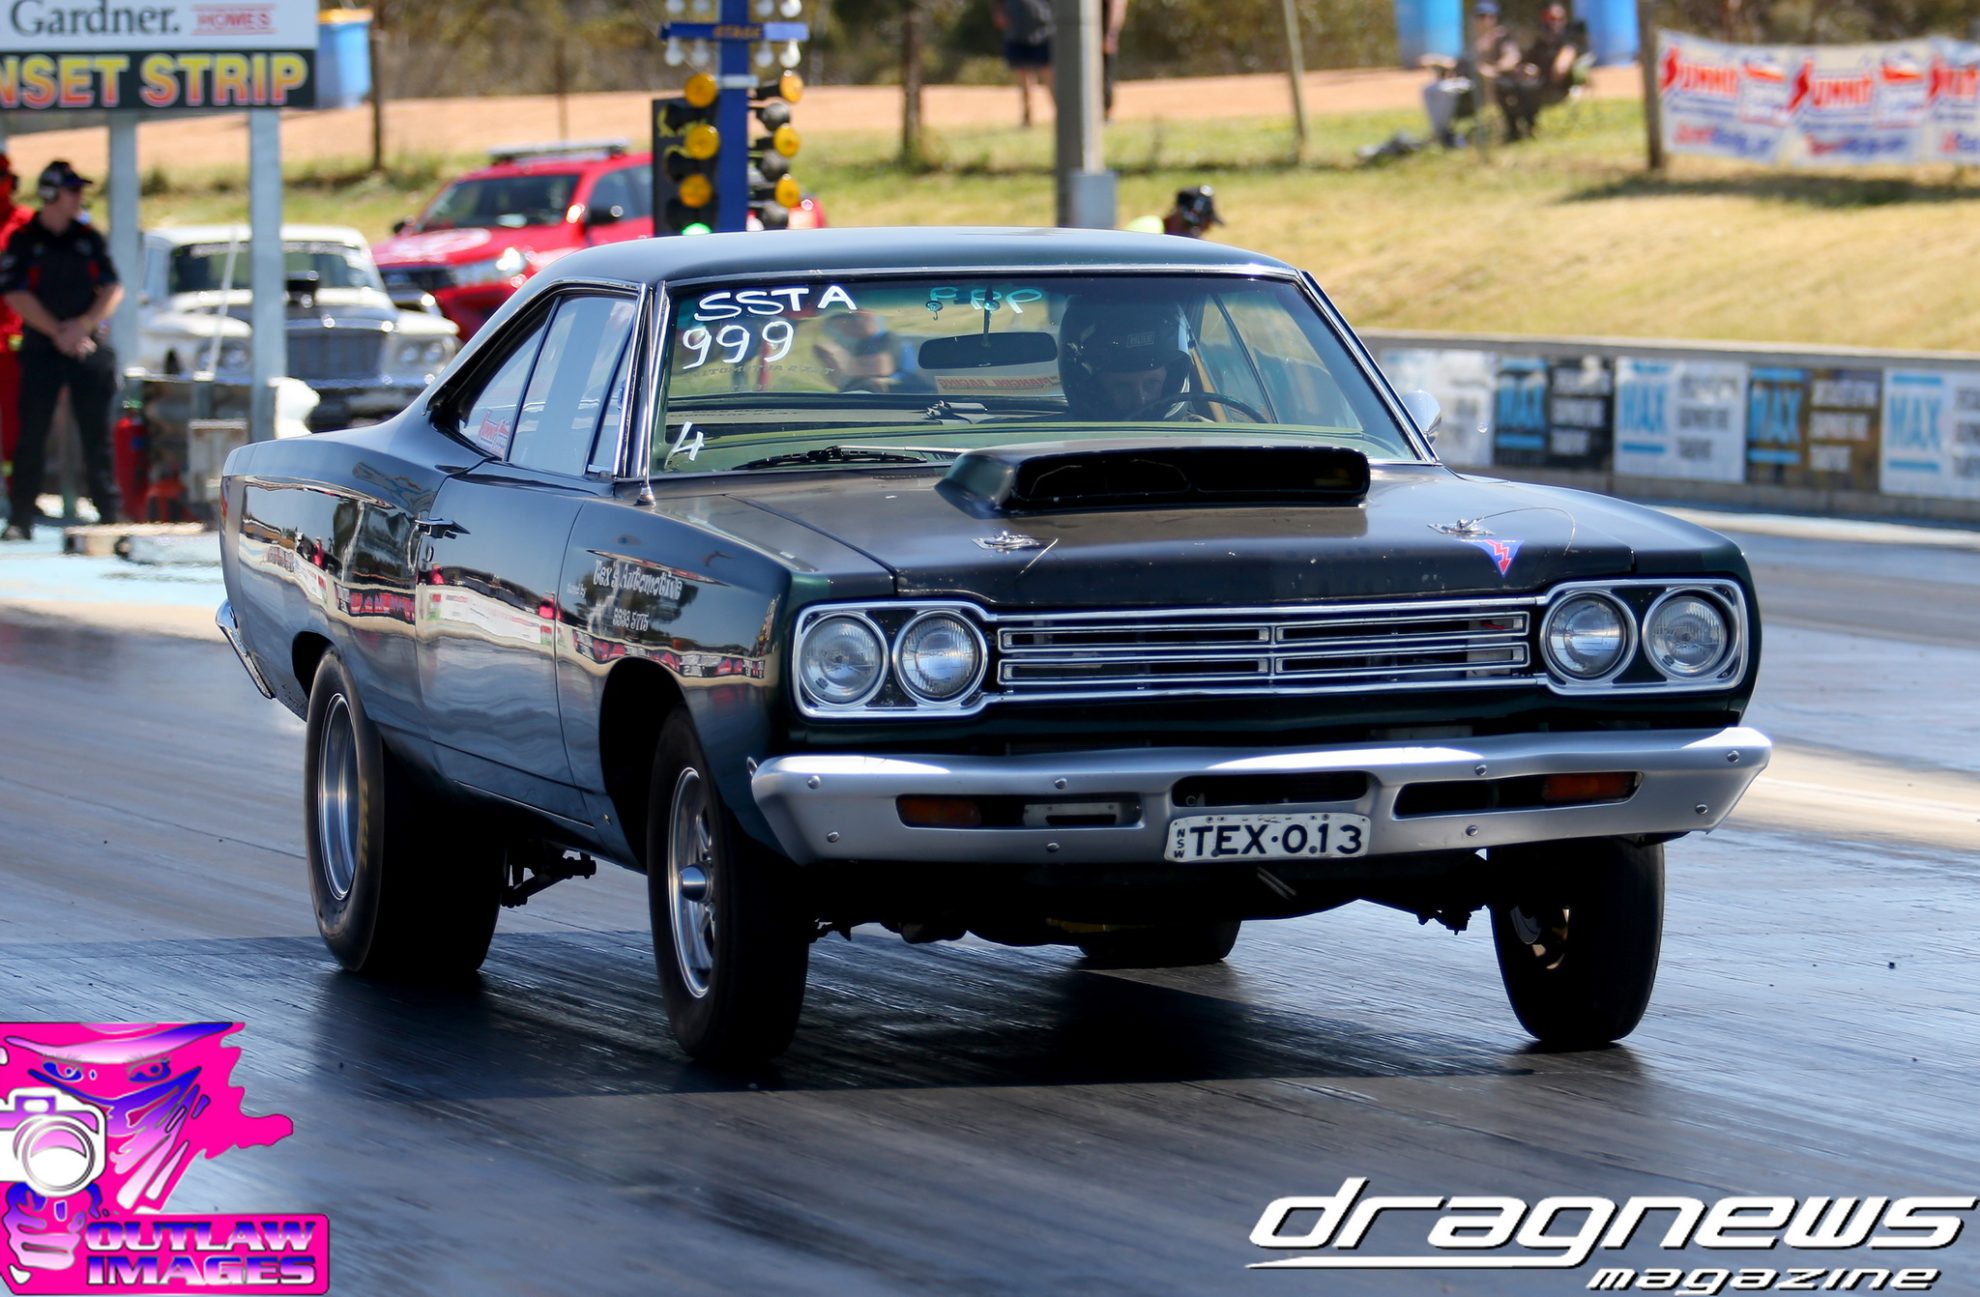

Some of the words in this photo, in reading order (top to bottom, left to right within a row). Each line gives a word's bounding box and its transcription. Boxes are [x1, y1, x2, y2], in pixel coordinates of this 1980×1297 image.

[11, 0, 180, 35] Gardner.
[196, 13, 271, 29] HOMES
[139, 53, 308, 107] STRIP
[682, 320, 795, 370] 999
[664, 421, 705, 469] 4
